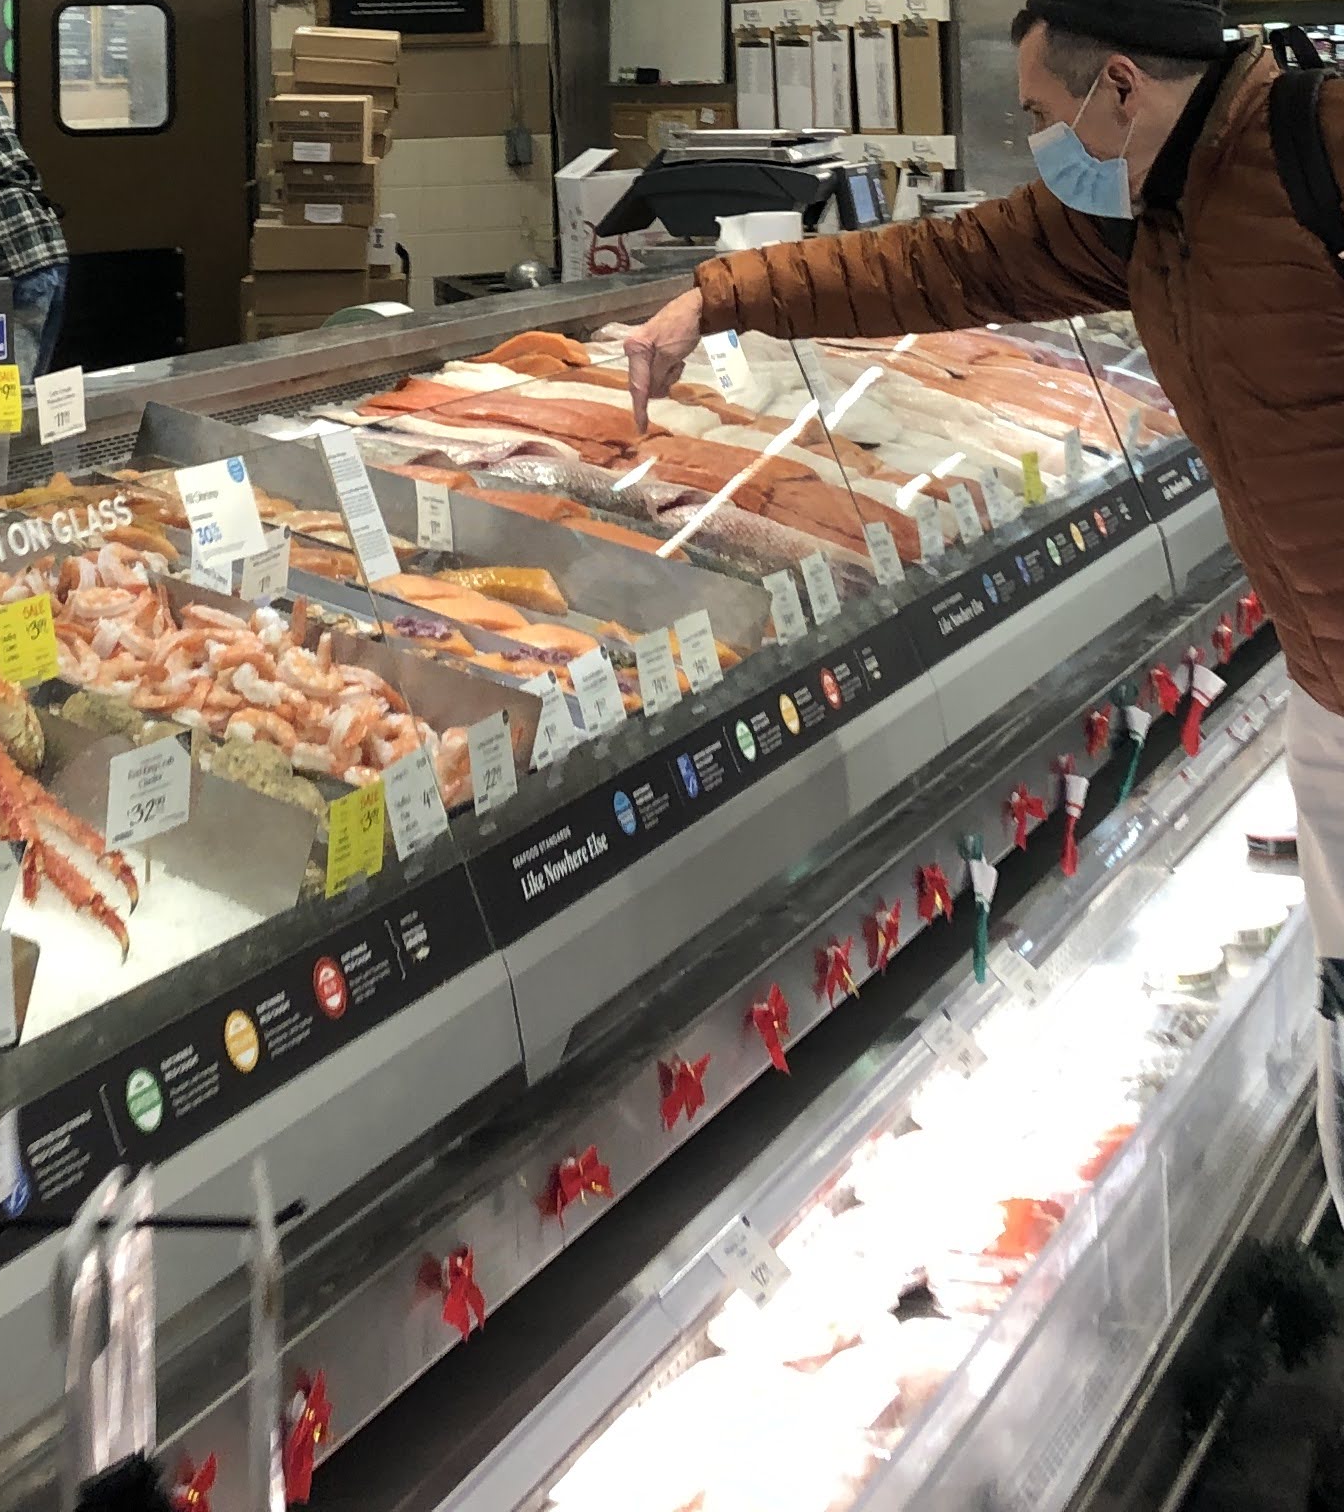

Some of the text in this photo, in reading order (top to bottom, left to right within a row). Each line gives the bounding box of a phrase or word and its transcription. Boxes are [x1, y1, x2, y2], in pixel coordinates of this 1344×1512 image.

[7, 516, 53, 558] ON
[51, 494, 135, 545] GLASS
[520, 831, 609, 903] Like Nowhere Else
